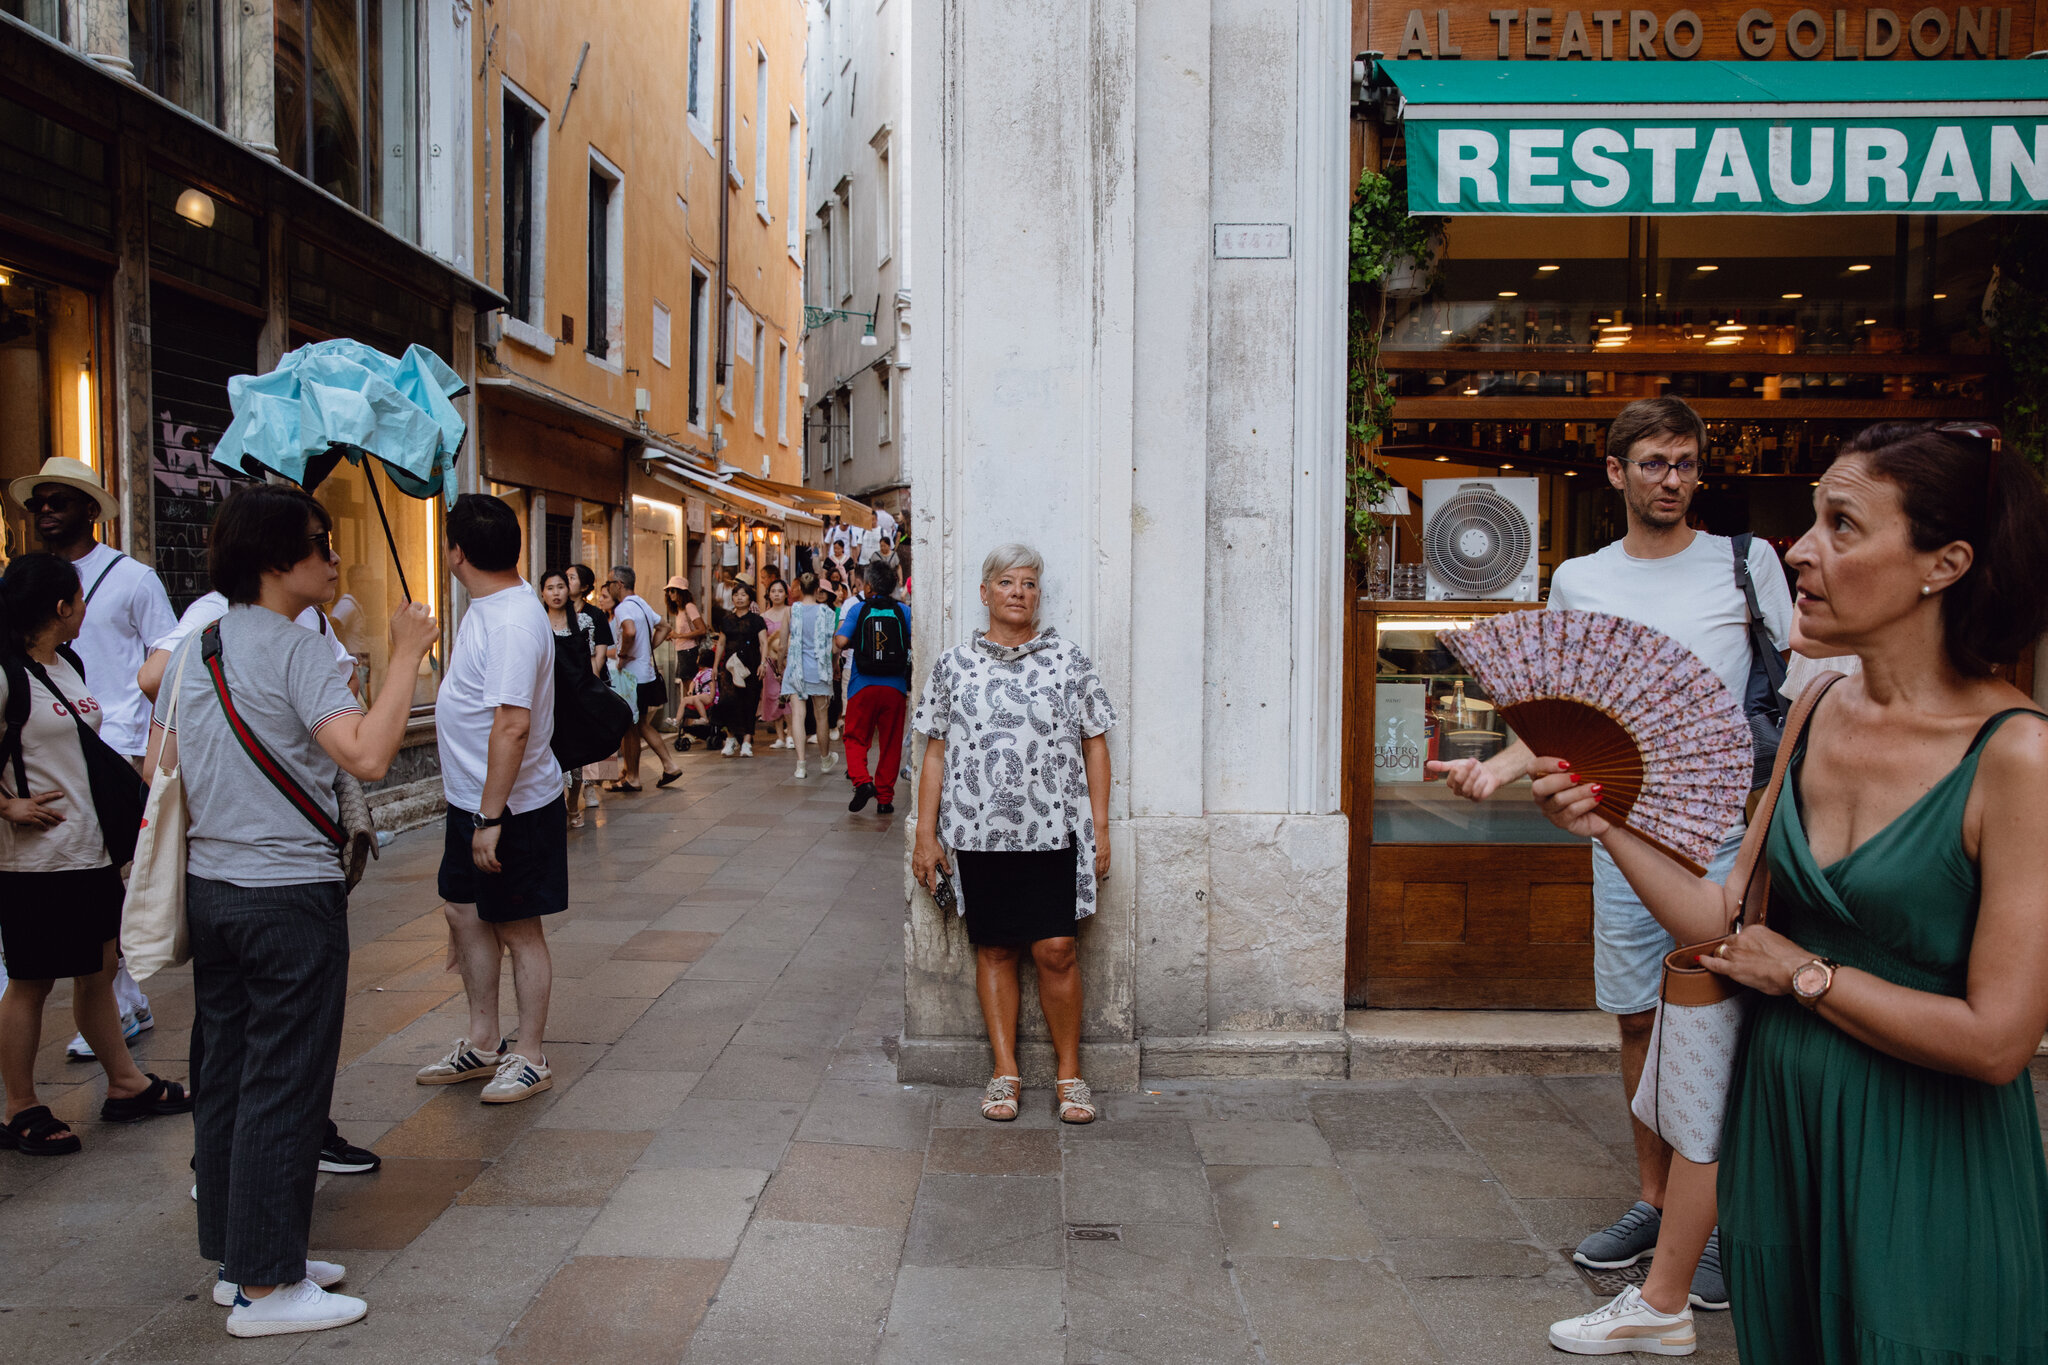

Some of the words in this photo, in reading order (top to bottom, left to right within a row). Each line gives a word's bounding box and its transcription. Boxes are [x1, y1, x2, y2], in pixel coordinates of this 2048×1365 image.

[1397, 9, 1462, 60] AL
[1490, 8, 1703, 60] TEATRO
[1736, 7, 2012, 60] GOLDONI
[1437, 125, 2048, 207] RESTAURAN
[1374, 754, 1419, 768] OLDONI
